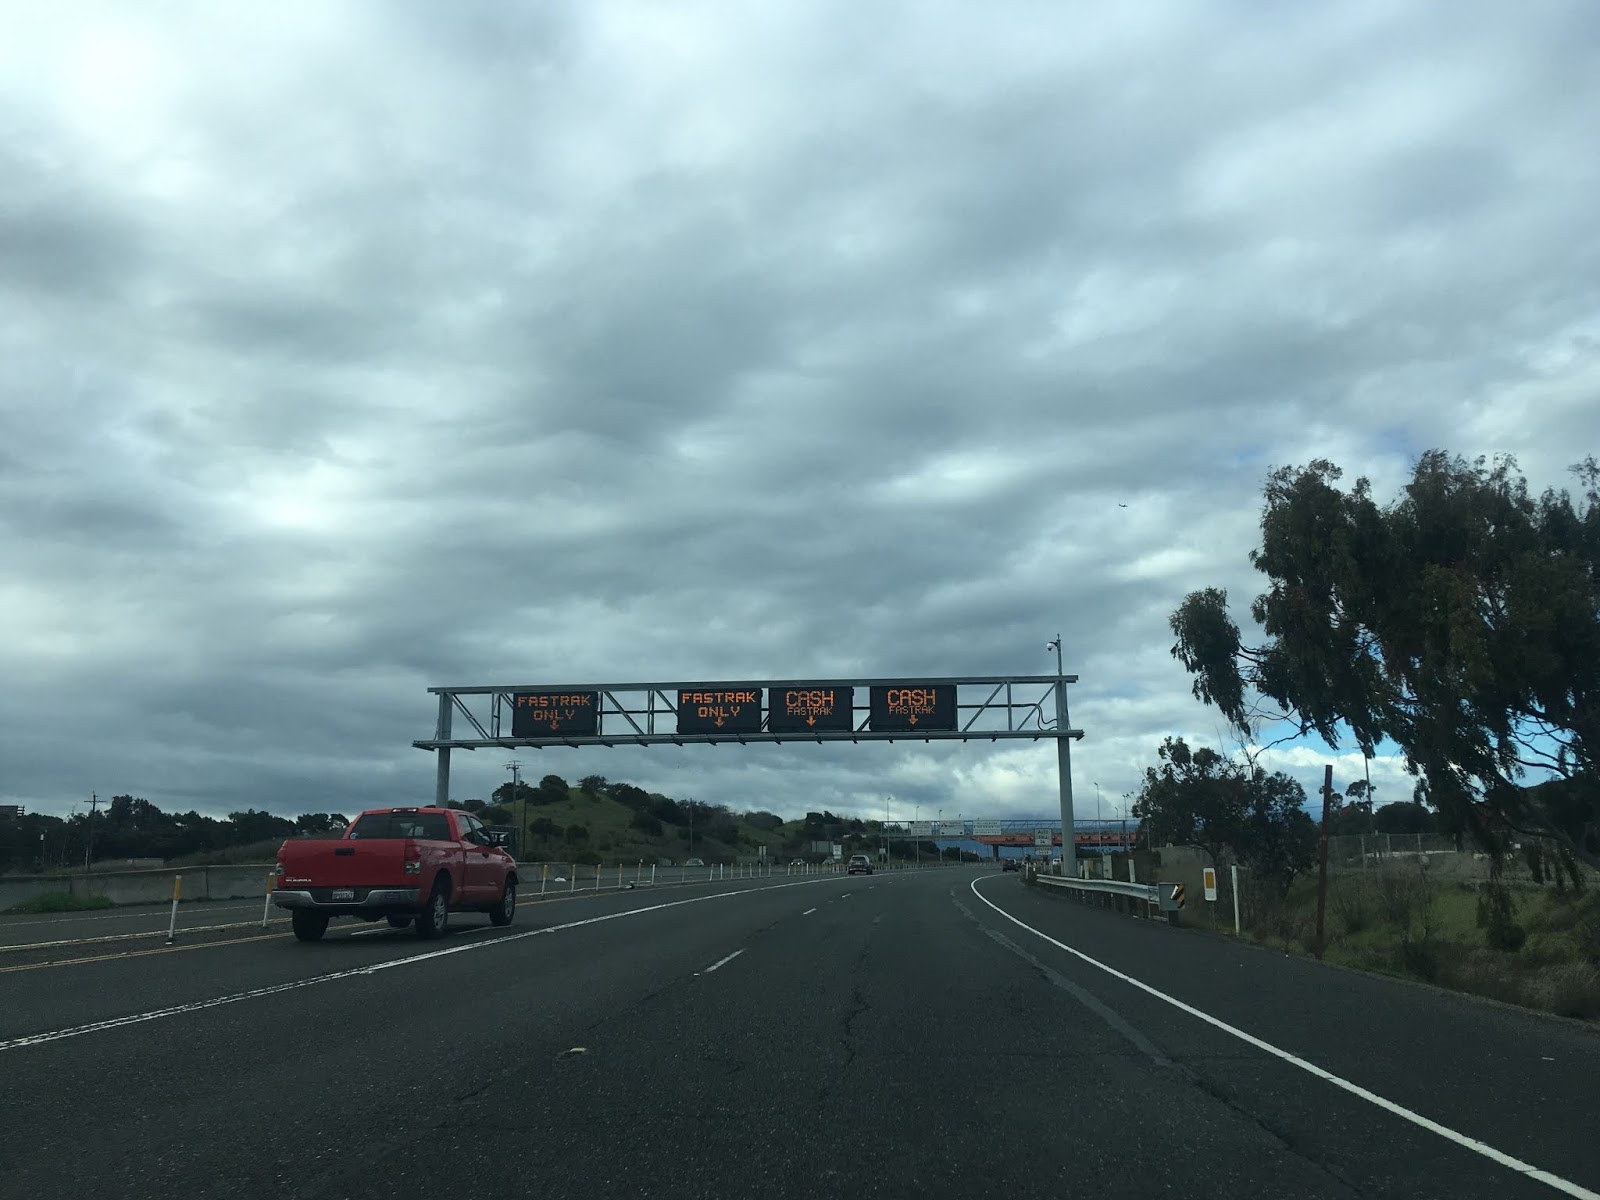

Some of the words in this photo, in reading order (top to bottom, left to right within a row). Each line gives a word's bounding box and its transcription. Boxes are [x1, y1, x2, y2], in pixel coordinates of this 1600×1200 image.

[517, 694, 591, 707] FASTRAK
[682, 691, 756, 704] FASTRAK
[786, 690, 834, 707] CASH
[887, 689, 936, 706] CASH
[533, 709, 575, 721] ONLY
[698, 705, 741, 718] ONLY
[787, 706, 833, 716] FASTRAK
[888, 705, 935, 715] FASTRAK
